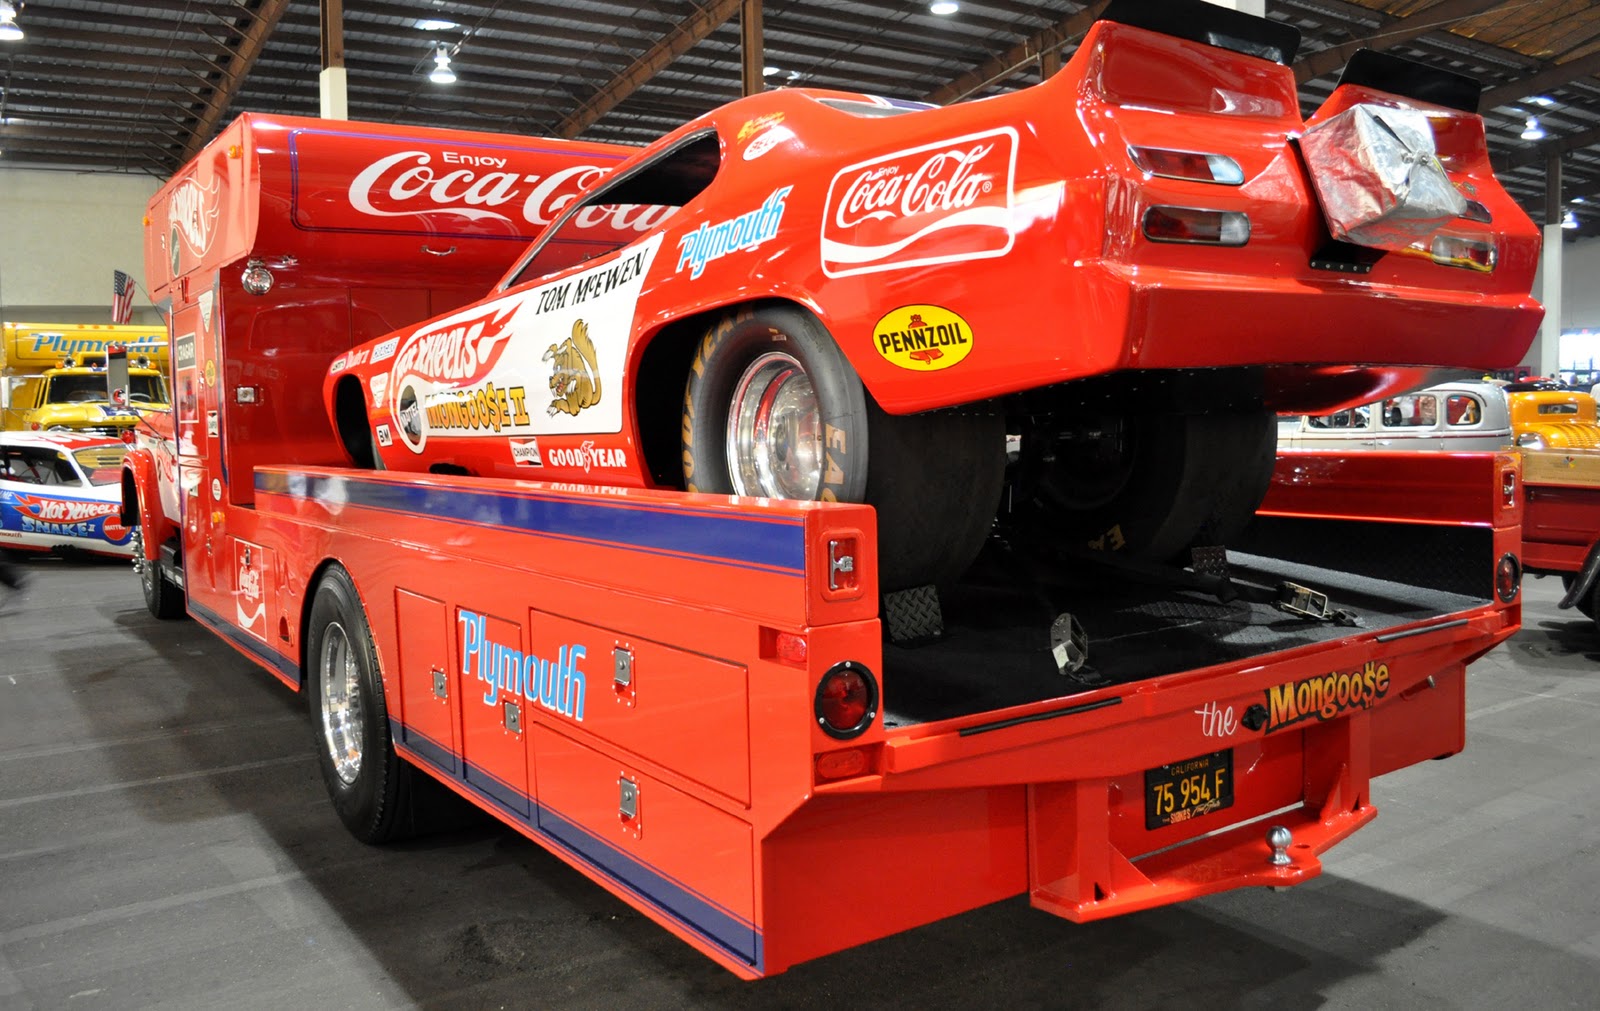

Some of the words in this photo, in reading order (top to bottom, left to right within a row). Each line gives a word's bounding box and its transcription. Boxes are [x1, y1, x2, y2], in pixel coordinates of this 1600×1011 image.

[442, 151, 507, 168] Enjoy
[836, 142, 994, 229] Coca-Cola
[675, 184, 794, 280] Plymouth
[535, 283, 572, 315] TOM
[878, 322, 968, 355] PENNZOIL
[21, 515, 88, 537] SNAKE
[458, 609, 587, 722] Plymouth
[1194, 700, 1238, 737] the
[1170, 758, 1210, 777] CALIFORNIA
[1153, 781, 1175, 816] 75
[1180, 772, 1211, 809] 954
[1215, 767, 1226, 799] F
